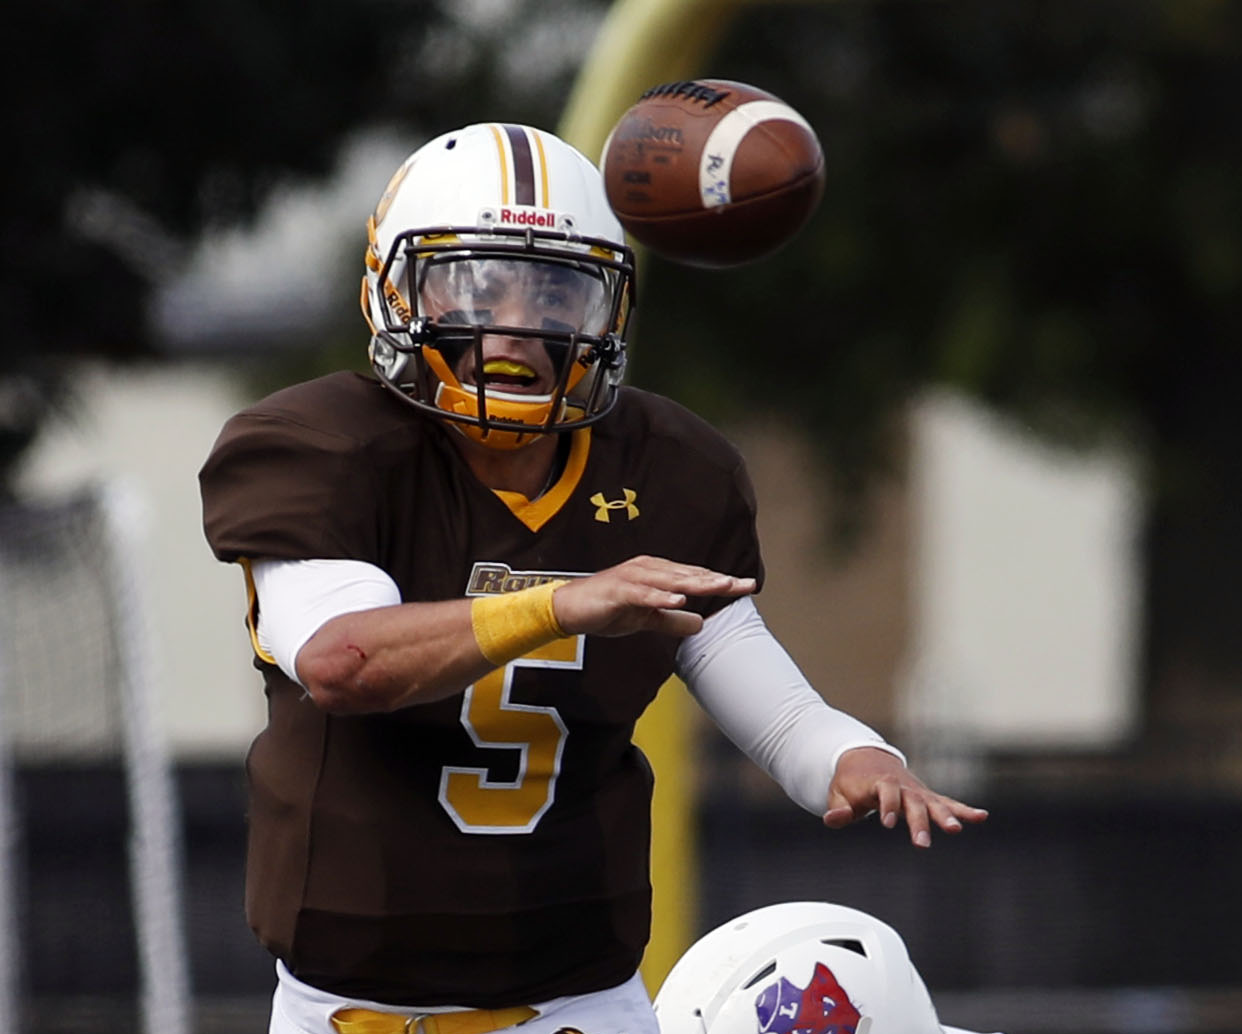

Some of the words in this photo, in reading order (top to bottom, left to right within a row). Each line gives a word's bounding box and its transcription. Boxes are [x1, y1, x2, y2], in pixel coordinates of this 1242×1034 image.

[501, 209, 555, 227] Riddell
[437, 632, 587, 835] 5
[779, 1001, 800, 1020] L
